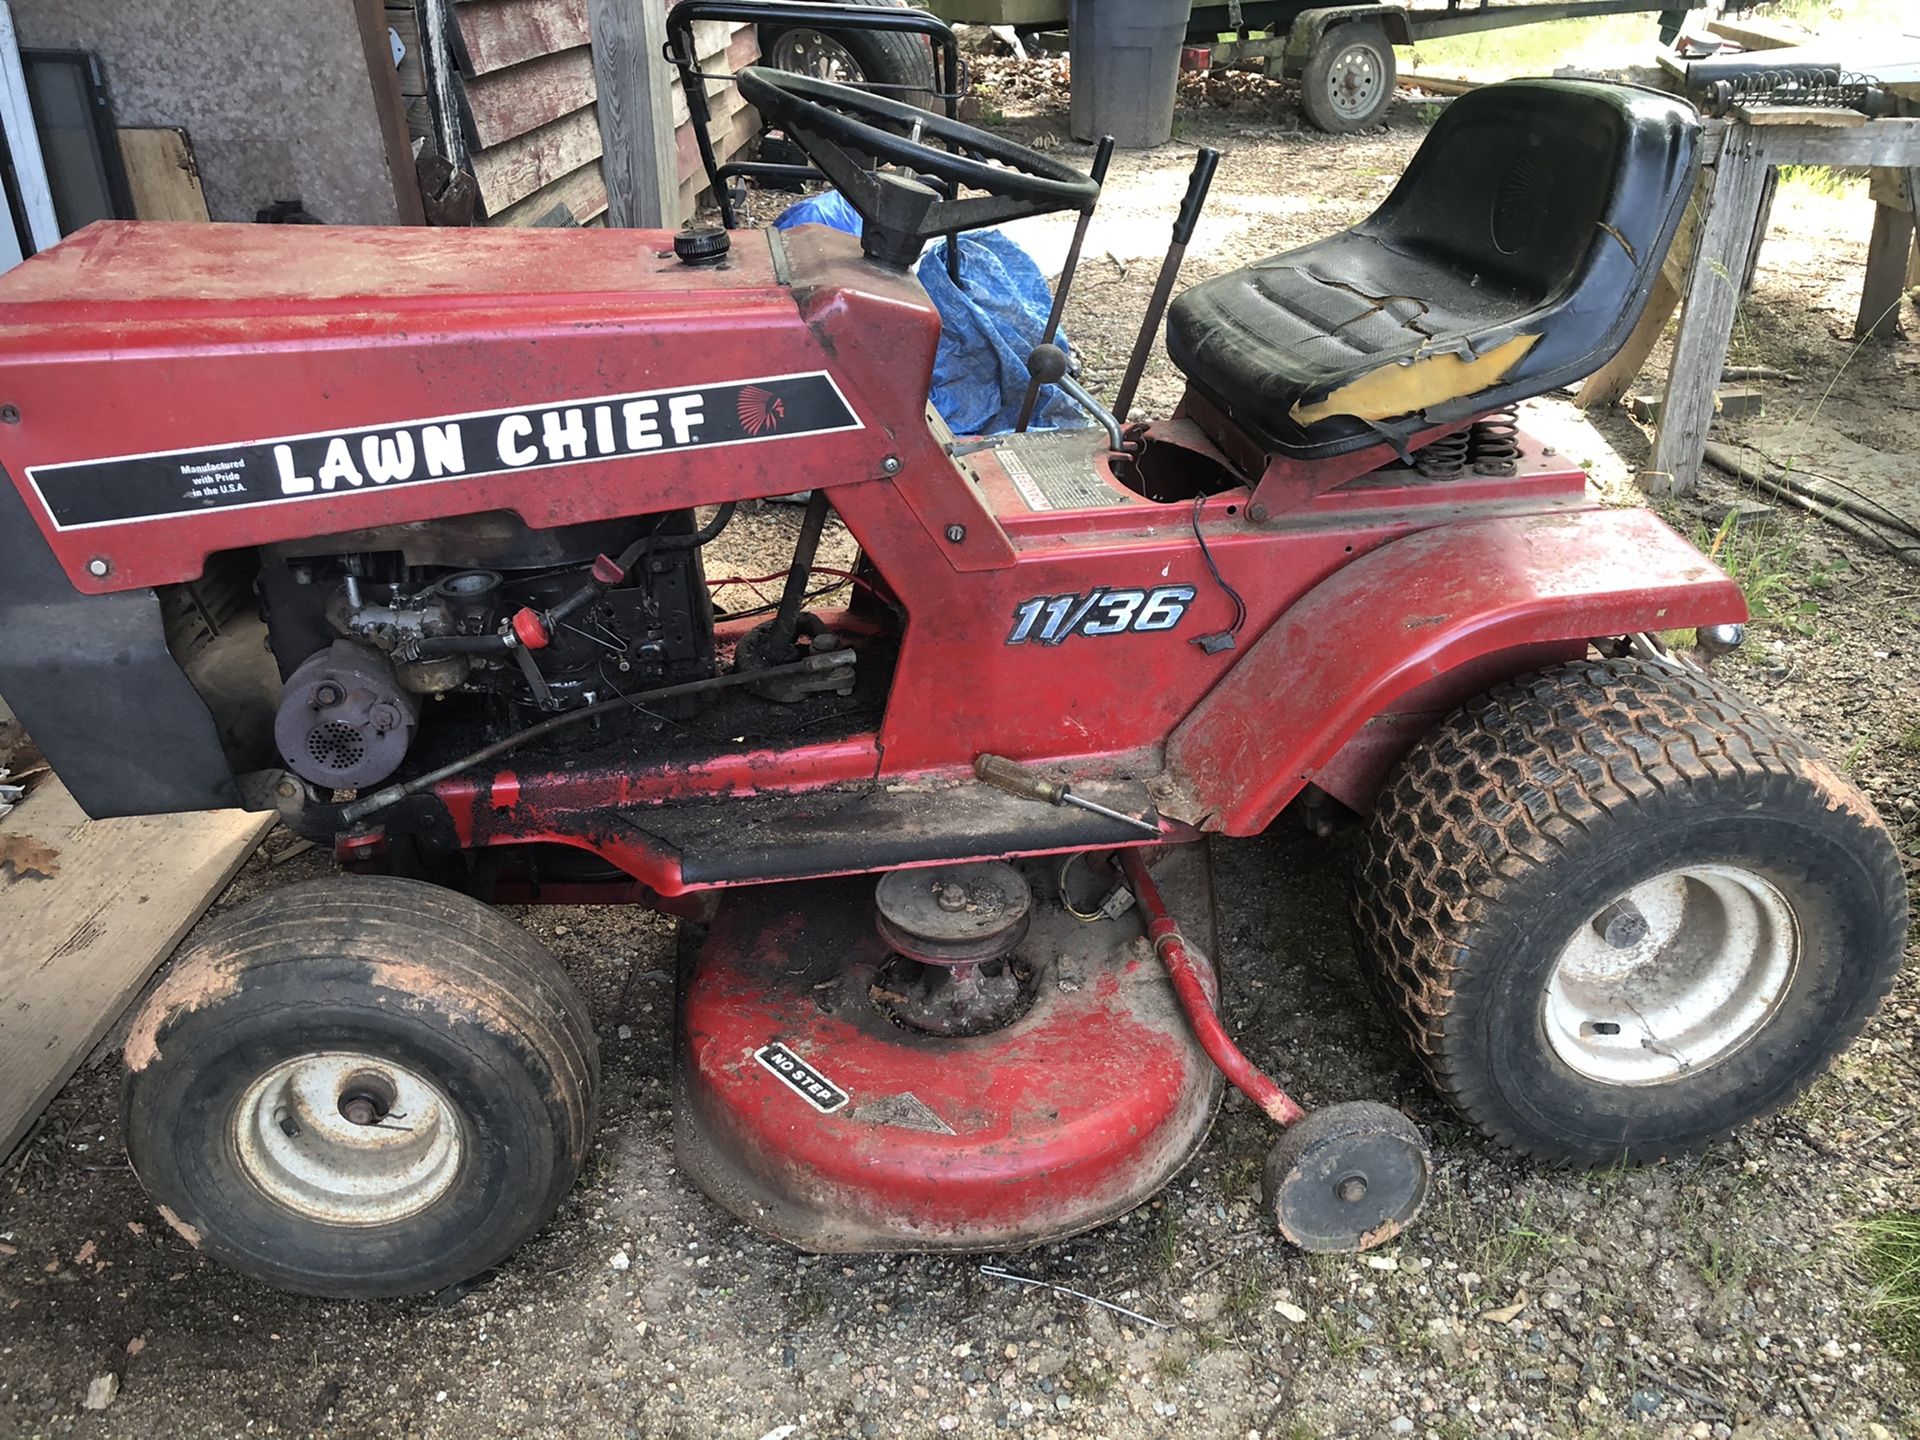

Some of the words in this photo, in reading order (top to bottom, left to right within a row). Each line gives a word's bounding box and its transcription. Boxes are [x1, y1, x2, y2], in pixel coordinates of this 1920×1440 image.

[273, 423, 466, 494] LAWN
[497, 393, 704, 467] CHIEF
[180, 458, 246, 474] Manufactured
[192, 475, 214, 485] with
[215, 471, 241, 482] Pride
[192, 488, 202, 497] in
[203, 486, 219, 496] the
[219, 482, 247, 494] U.S.A.
[1006, 584, 1197, 645] 11/36
[771, 1053, 794, 1071] NO
[792, 1070, 831, 1100] STEP
